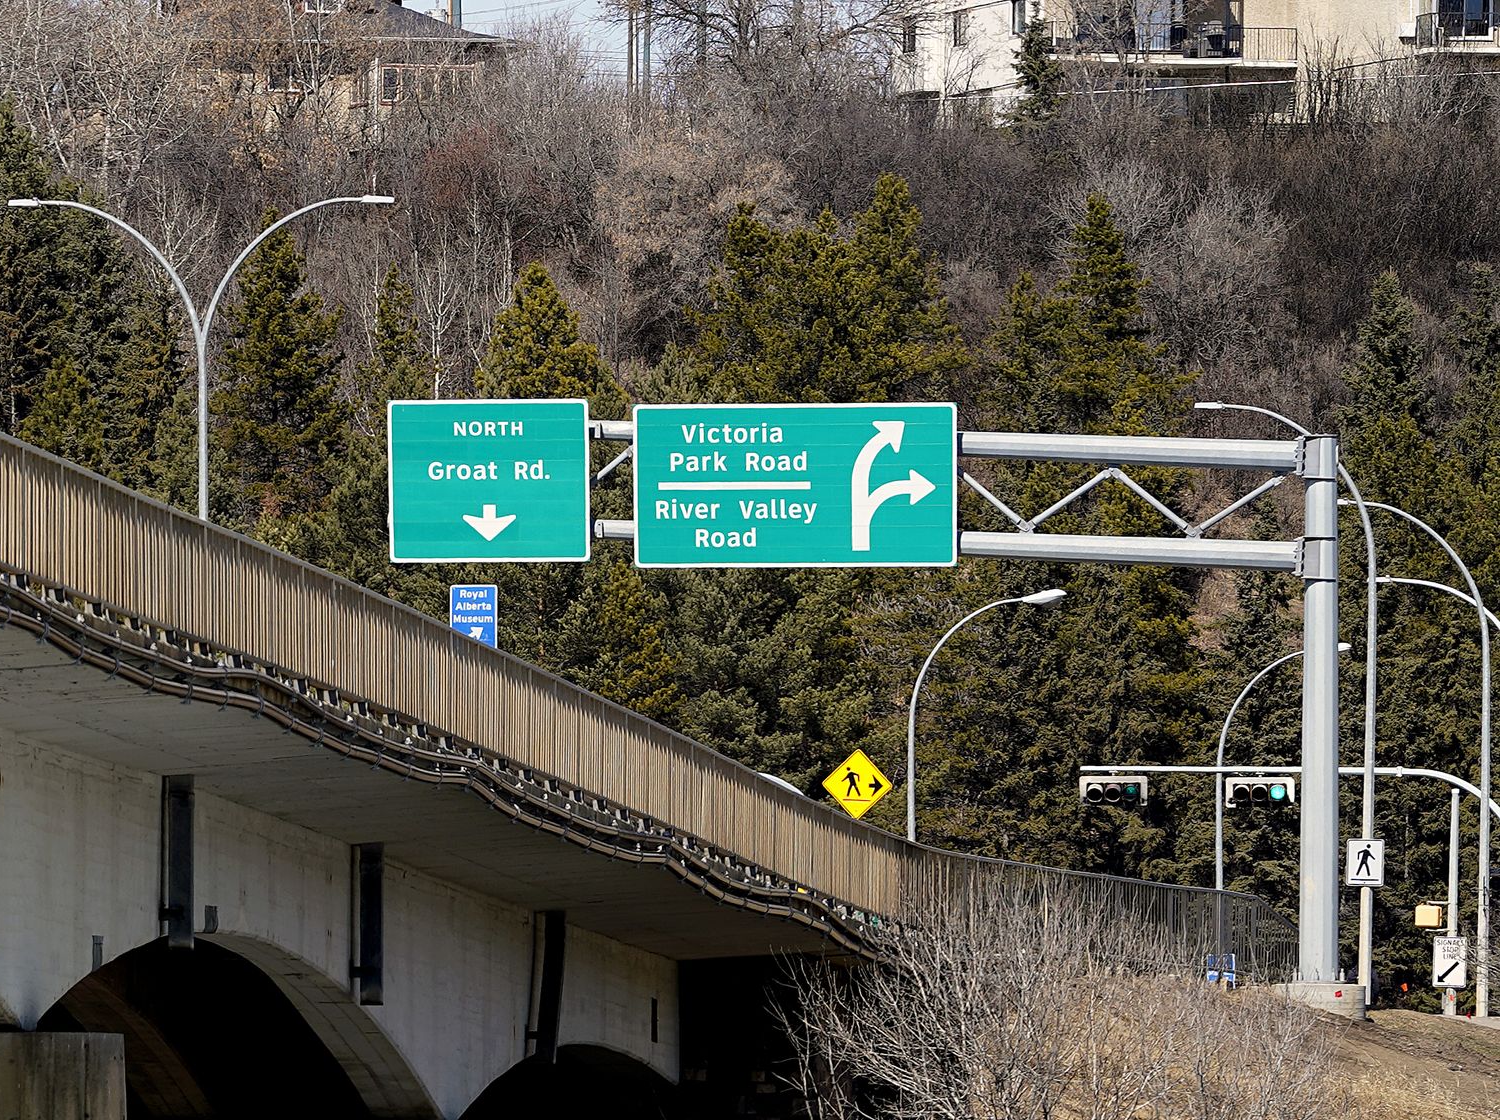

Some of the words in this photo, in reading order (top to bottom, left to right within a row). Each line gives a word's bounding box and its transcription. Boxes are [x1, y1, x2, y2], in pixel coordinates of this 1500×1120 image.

[453, 421, 523, 437] NORTH
[681, 422, 784, 444] Victoria
[427, 461, 498, 481] Groat
[514, 459, 551, 480] Rd.
[669, 451, 728, 472] Park
[745, 450, 808, 472] Road
[655, 498, 721, 520] River
[739, 498, 818, 525] Valley
[695, 527, 758, 548] Road
[459, 589, 488, 600] Royal
[455, 602, 492, 611] Alberta
[453, 614, 493, 623] Museum
